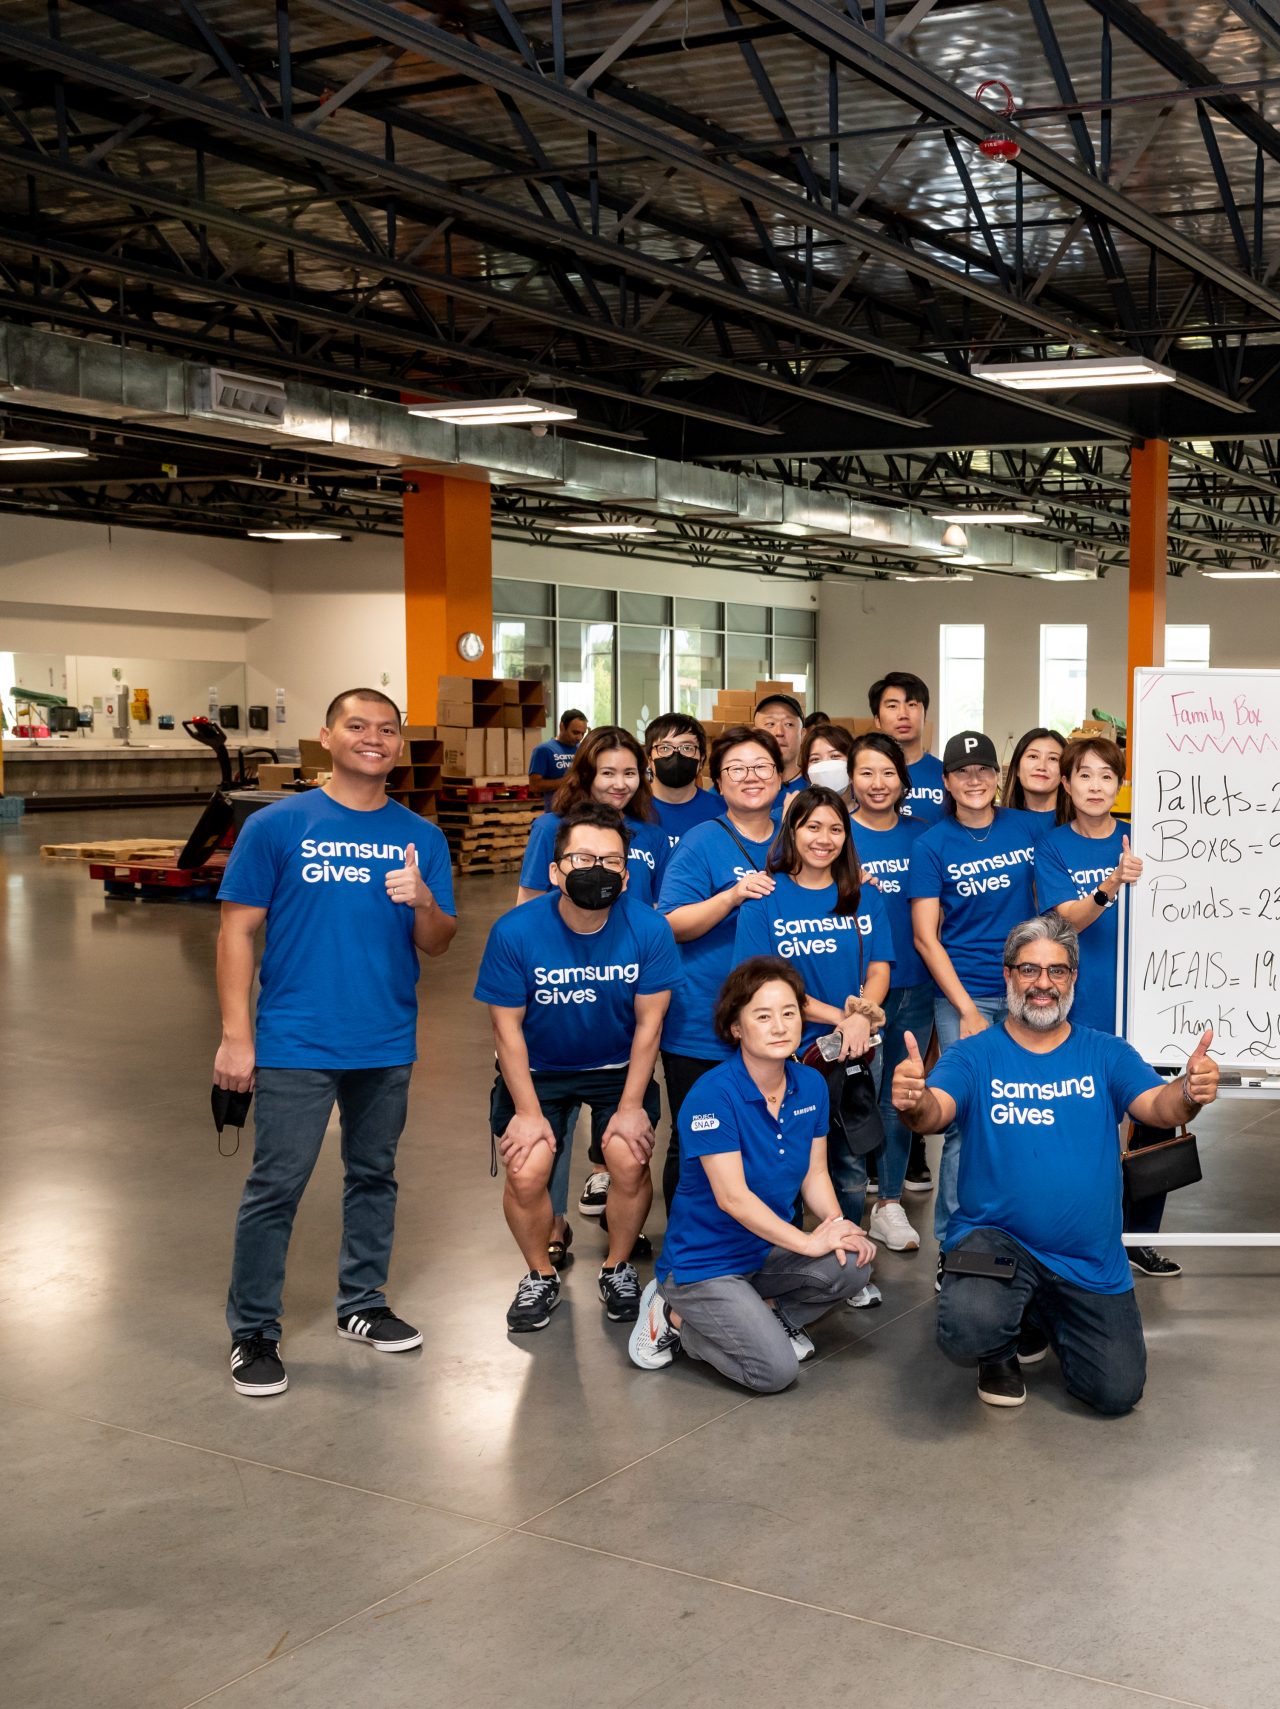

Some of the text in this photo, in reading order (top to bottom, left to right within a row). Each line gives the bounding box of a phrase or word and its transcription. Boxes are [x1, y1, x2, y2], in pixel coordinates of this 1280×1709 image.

[1168, 691, 1263, 740] Family Box
[964, 737, 979, 754] P
[1156, 770, 1252, 817] Pallets
[1146, 819, 1242, 864] Boxes
[301, 860, 371, 883] Gives
[861, 858, 910, 875] amsu
[956, 873, 1011, 897] Gives
[1149, 875, 1234, 922] Pounds
[773, 914, 873, 937] Samsung
[777, 937, 837, 958] Gives
[534, 963, 639, 985] Samsung
[535, 987, 597, 1004] Gives
[991, 1075, 1095, 1101] Samsung
[692, 1113, 715, 1121] PROJECT
[793, 1104, 817, 1116] SAMSUNG
[990, 1101, 1055, 1125] Gives
[694, 1120, 715, 1129] SNAP
